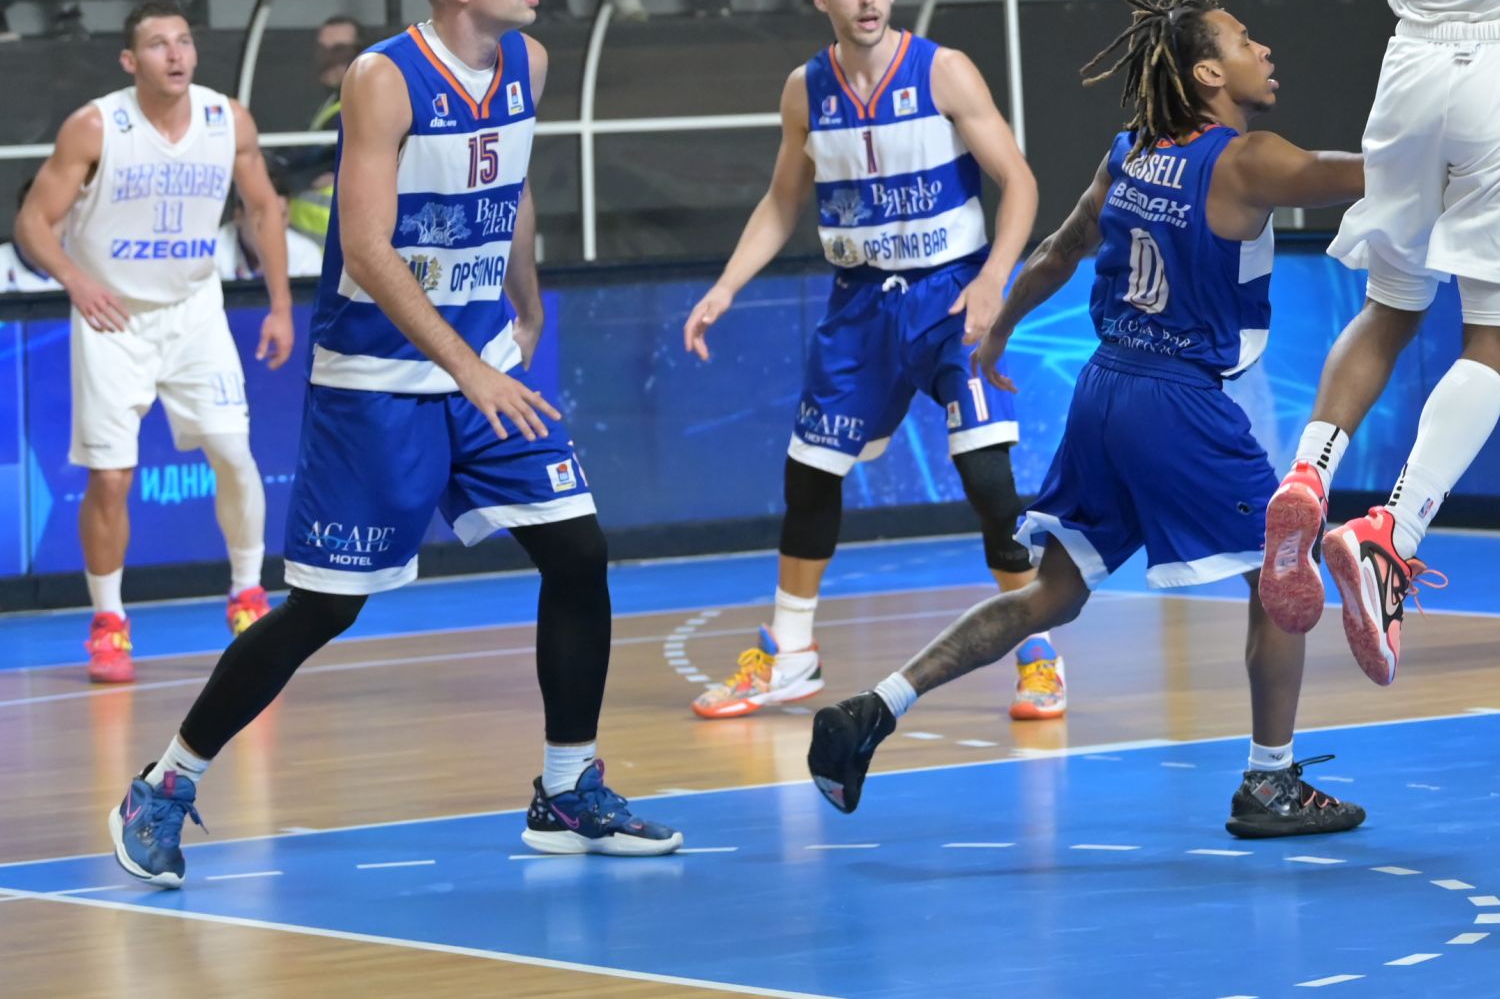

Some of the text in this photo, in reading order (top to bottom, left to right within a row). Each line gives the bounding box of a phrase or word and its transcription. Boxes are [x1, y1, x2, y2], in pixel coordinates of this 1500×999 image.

[467, 132, 499, 189] 15
[862, 130, 877, 174] 1
[155, 161, 227, 202] SKOPJE
[870, 175, 943, 206] Barsko
[152, 199, 184, 234] 11
[482, 210, 514, 237] zlat
[922, 227, 948, 257] BAR
[967, 377, 989, 423] 1
[141, 463, 217, 505] ИДНИ
[329, 553, 373, 567] HOTEL
